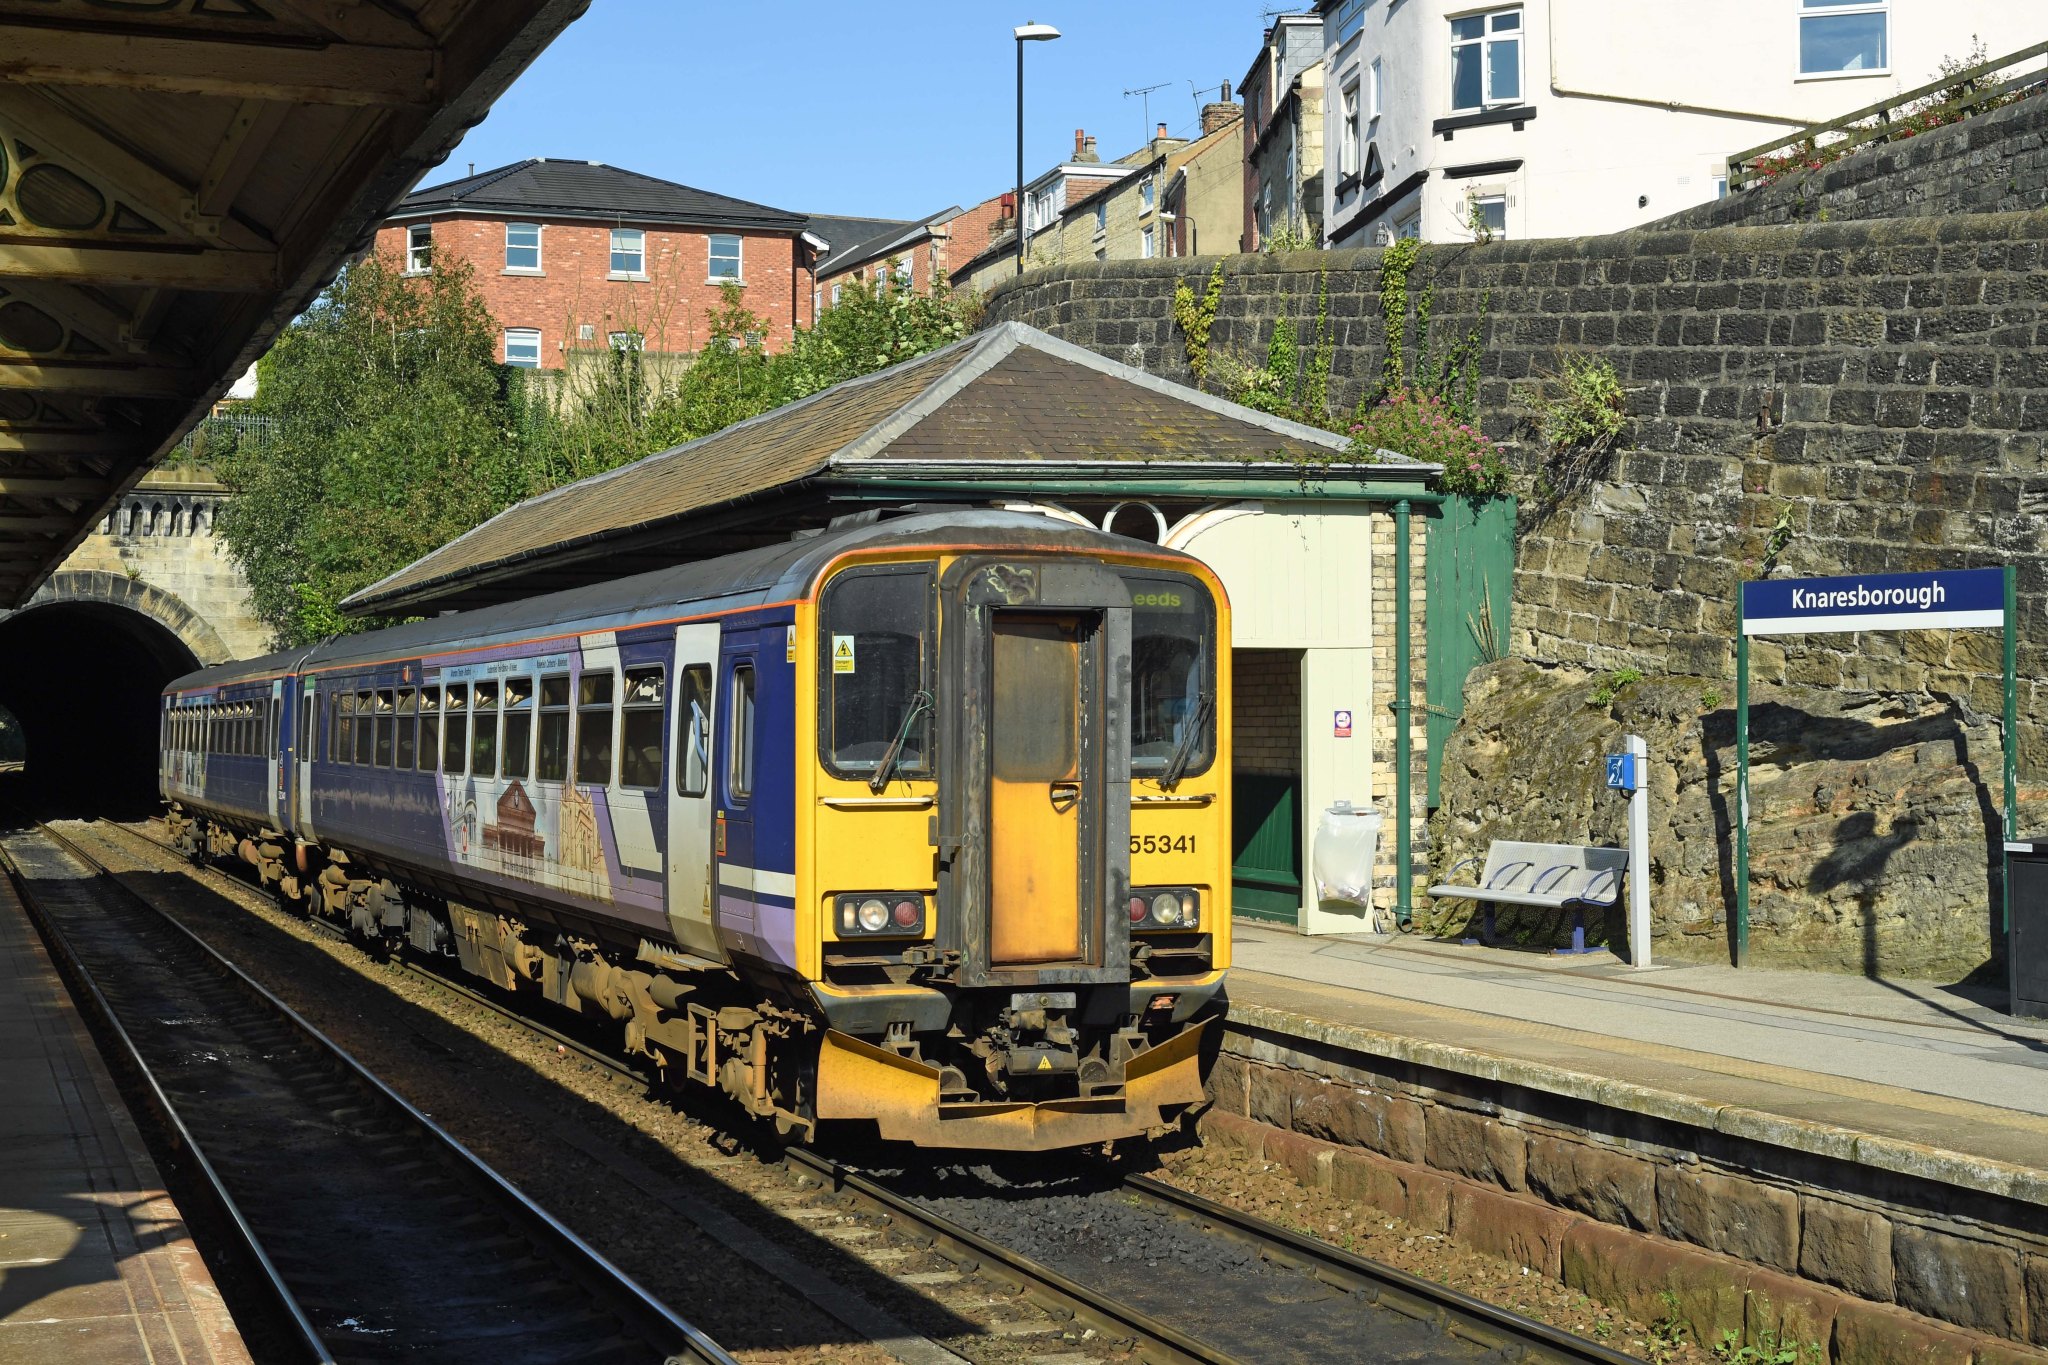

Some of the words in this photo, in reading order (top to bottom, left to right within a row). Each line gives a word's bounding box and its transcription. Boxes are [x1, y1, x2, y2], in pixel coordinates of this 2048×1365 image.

[1131, 592, 1181, 607] eeds
[1792, 581, 1945, 609] Knaresborough
[1130, 835, 1195, 854] 55341
